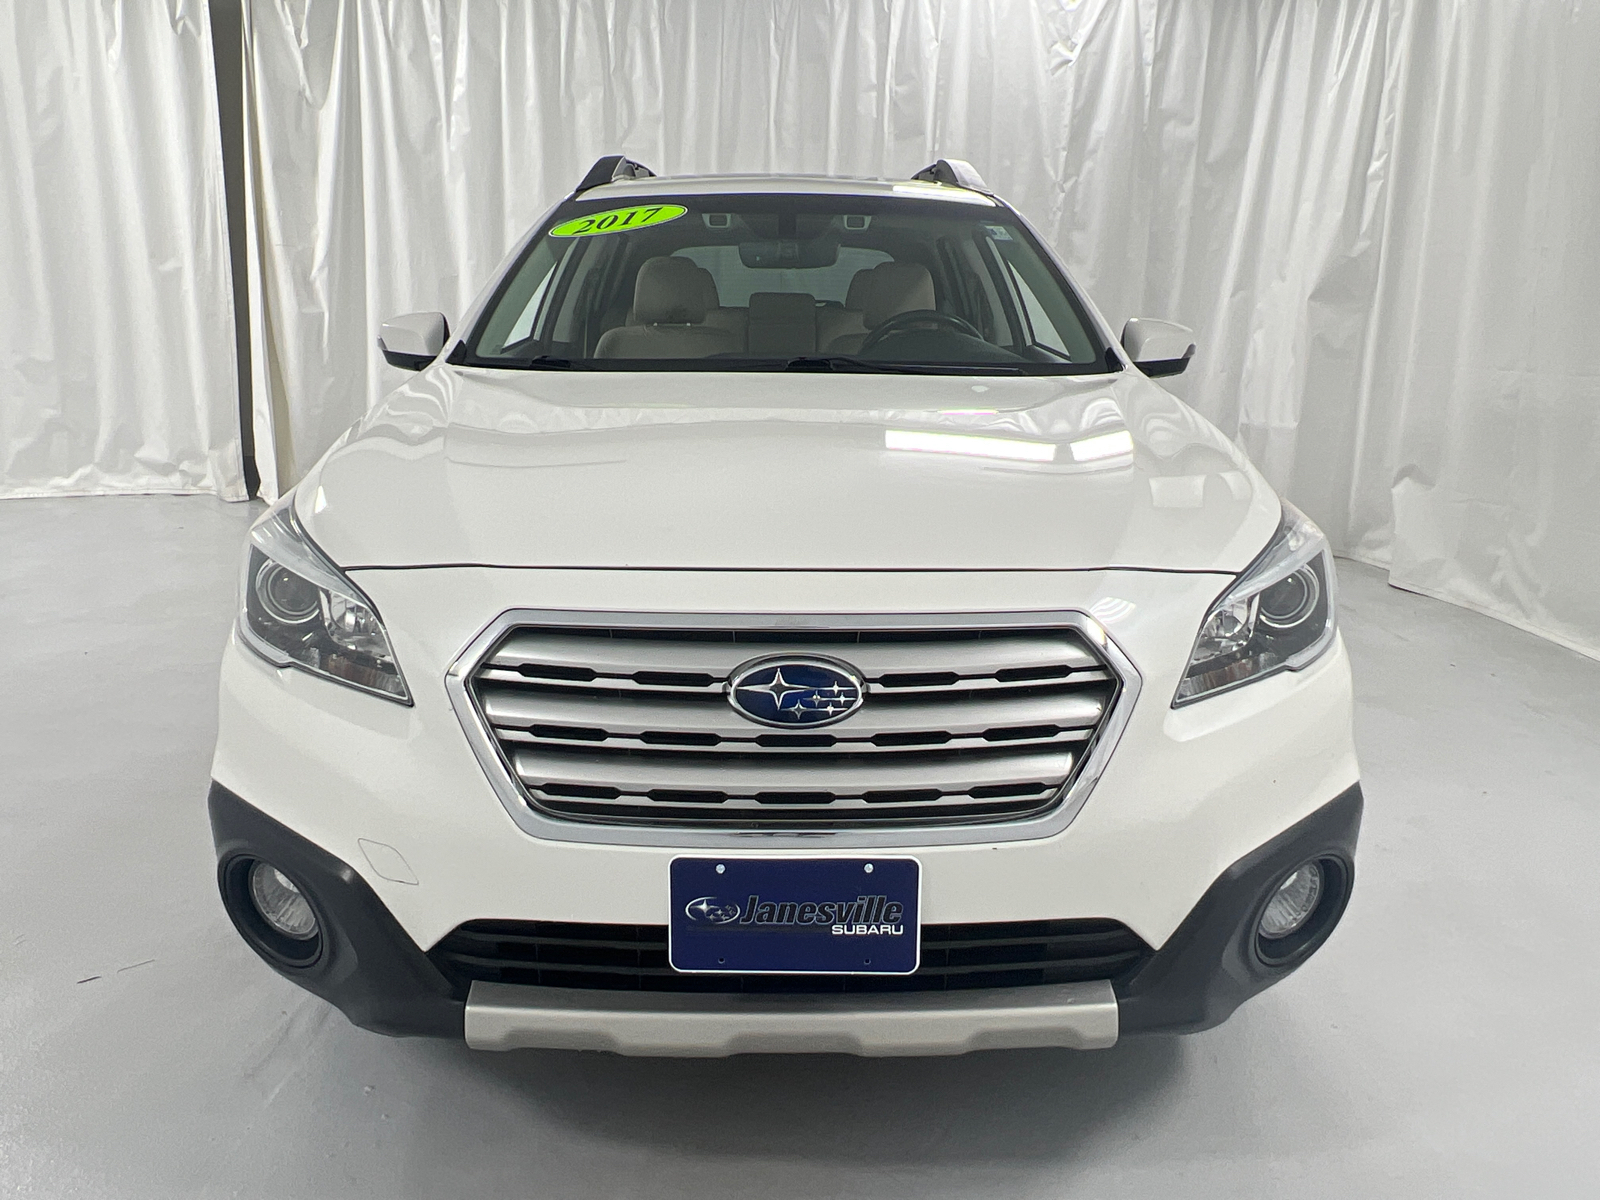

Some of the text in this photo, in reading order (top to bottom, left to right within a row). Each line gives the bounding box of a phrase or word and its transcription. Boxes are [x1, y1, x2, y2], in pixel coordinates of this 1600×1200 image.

[571, 207, 663, 236] 2017
[739, 895, 904, 925] Janesville
[831, 924, 904, 935] SUBARU
